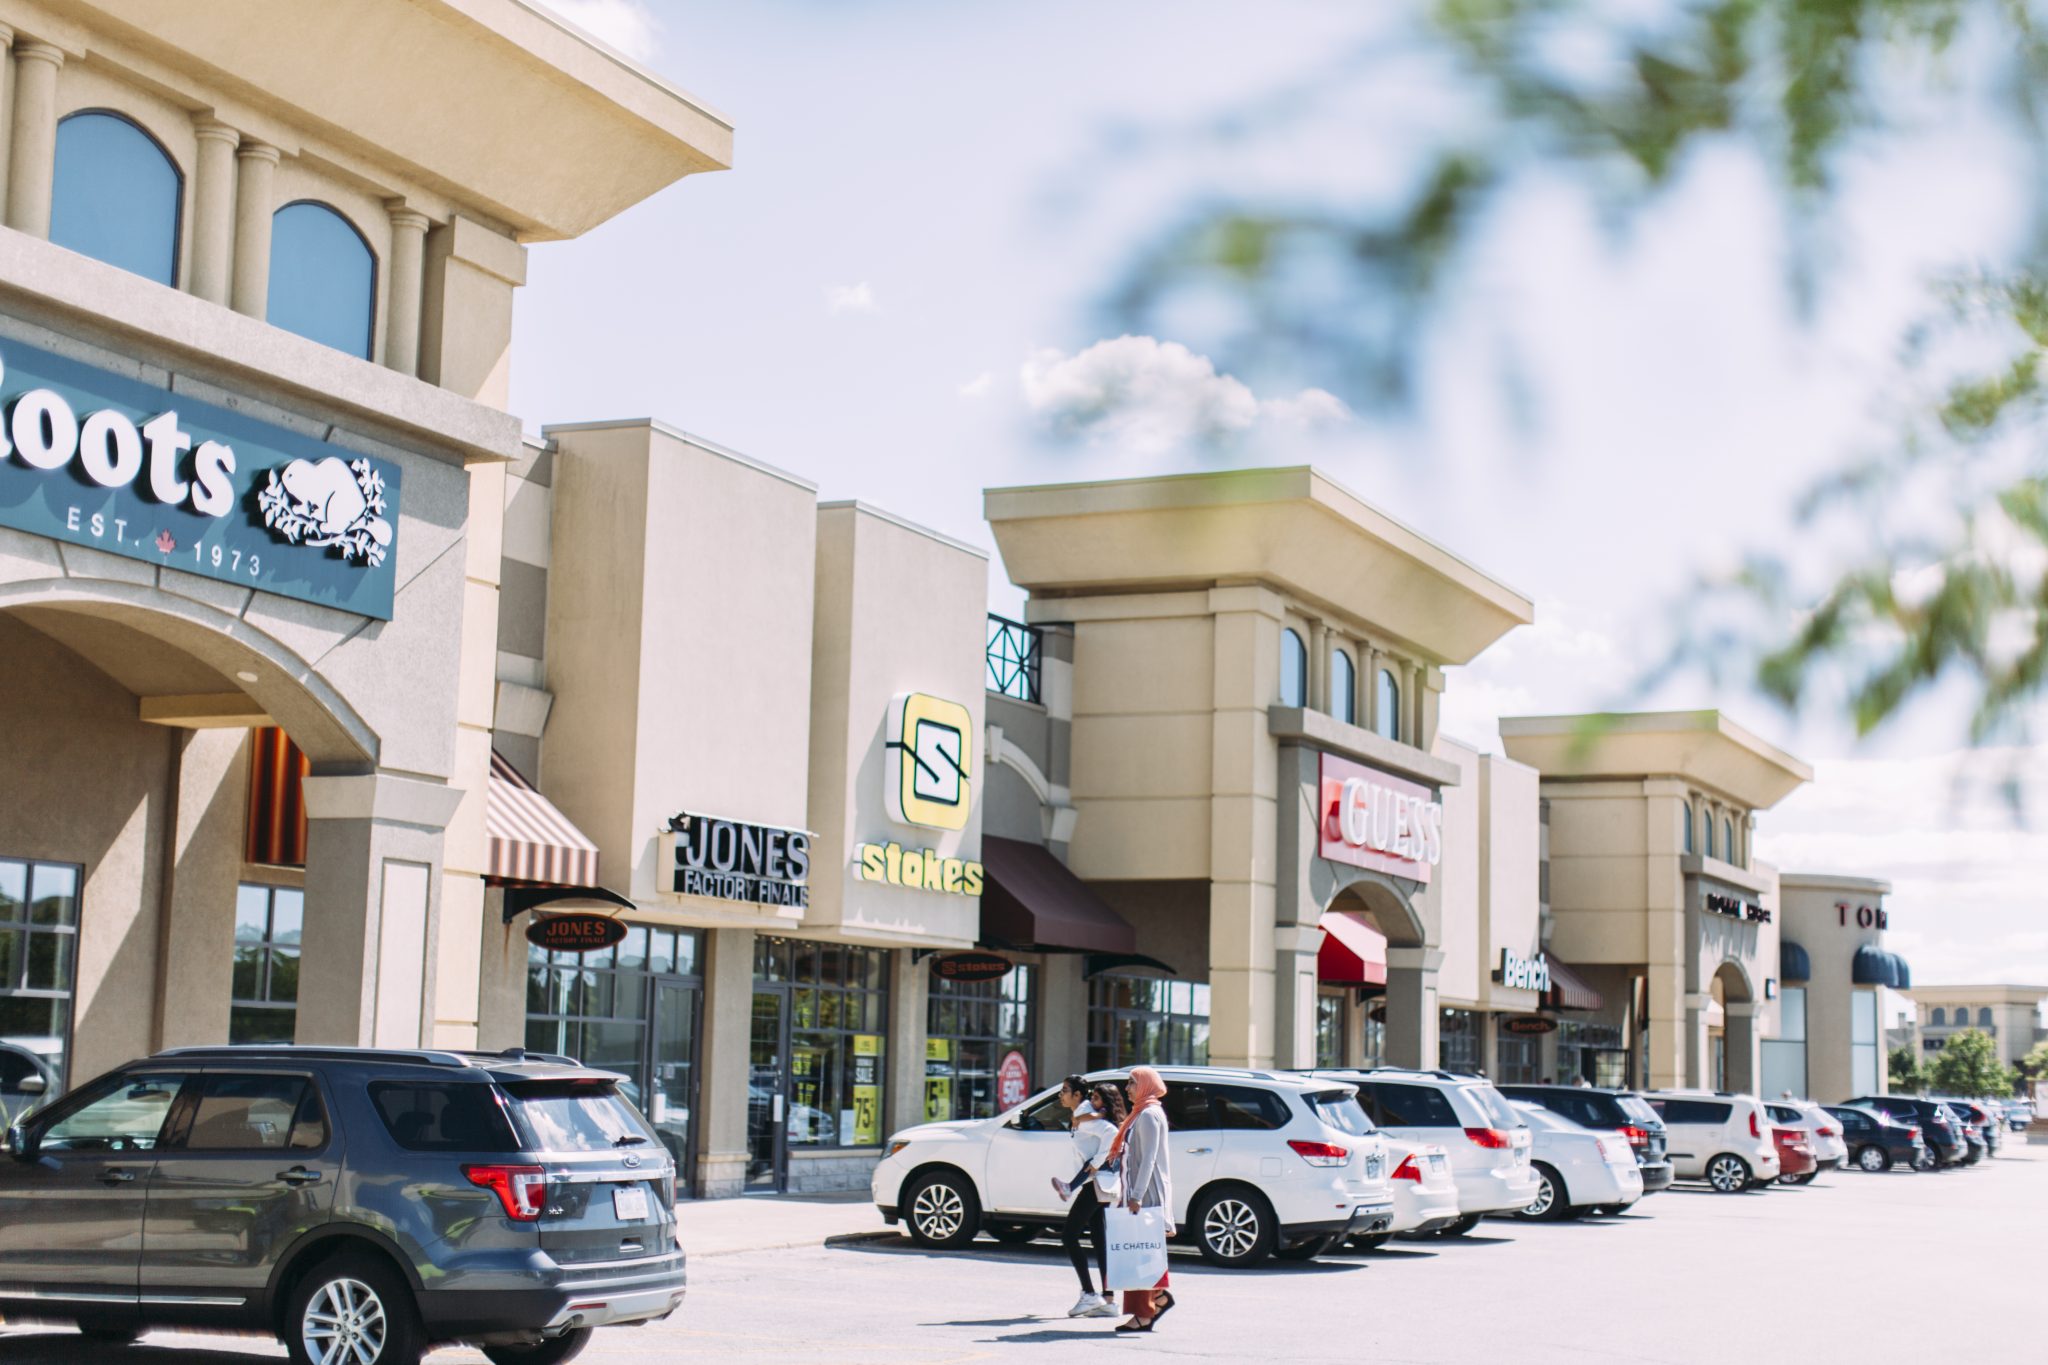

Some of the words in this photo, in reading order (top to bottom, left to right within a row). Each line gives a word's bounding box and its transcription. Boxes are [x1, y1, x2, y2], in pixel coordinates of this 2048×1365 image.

[0, 356, 236, 518] oots
[67, 506, 140, 547] EST.
[194, 540, 260, 576] 1973
[686, 817, 810, 881] JONES
[1341, 777, 1442, 866] GUESS
[684, 869, 755, 901] FACTORY
[759, 879, 809, 908] FINALE
[858, 841, 984, 897] stokes
[546, 921, 606, 936] JONES
[1503, 948, 1552, 993] Bench.
